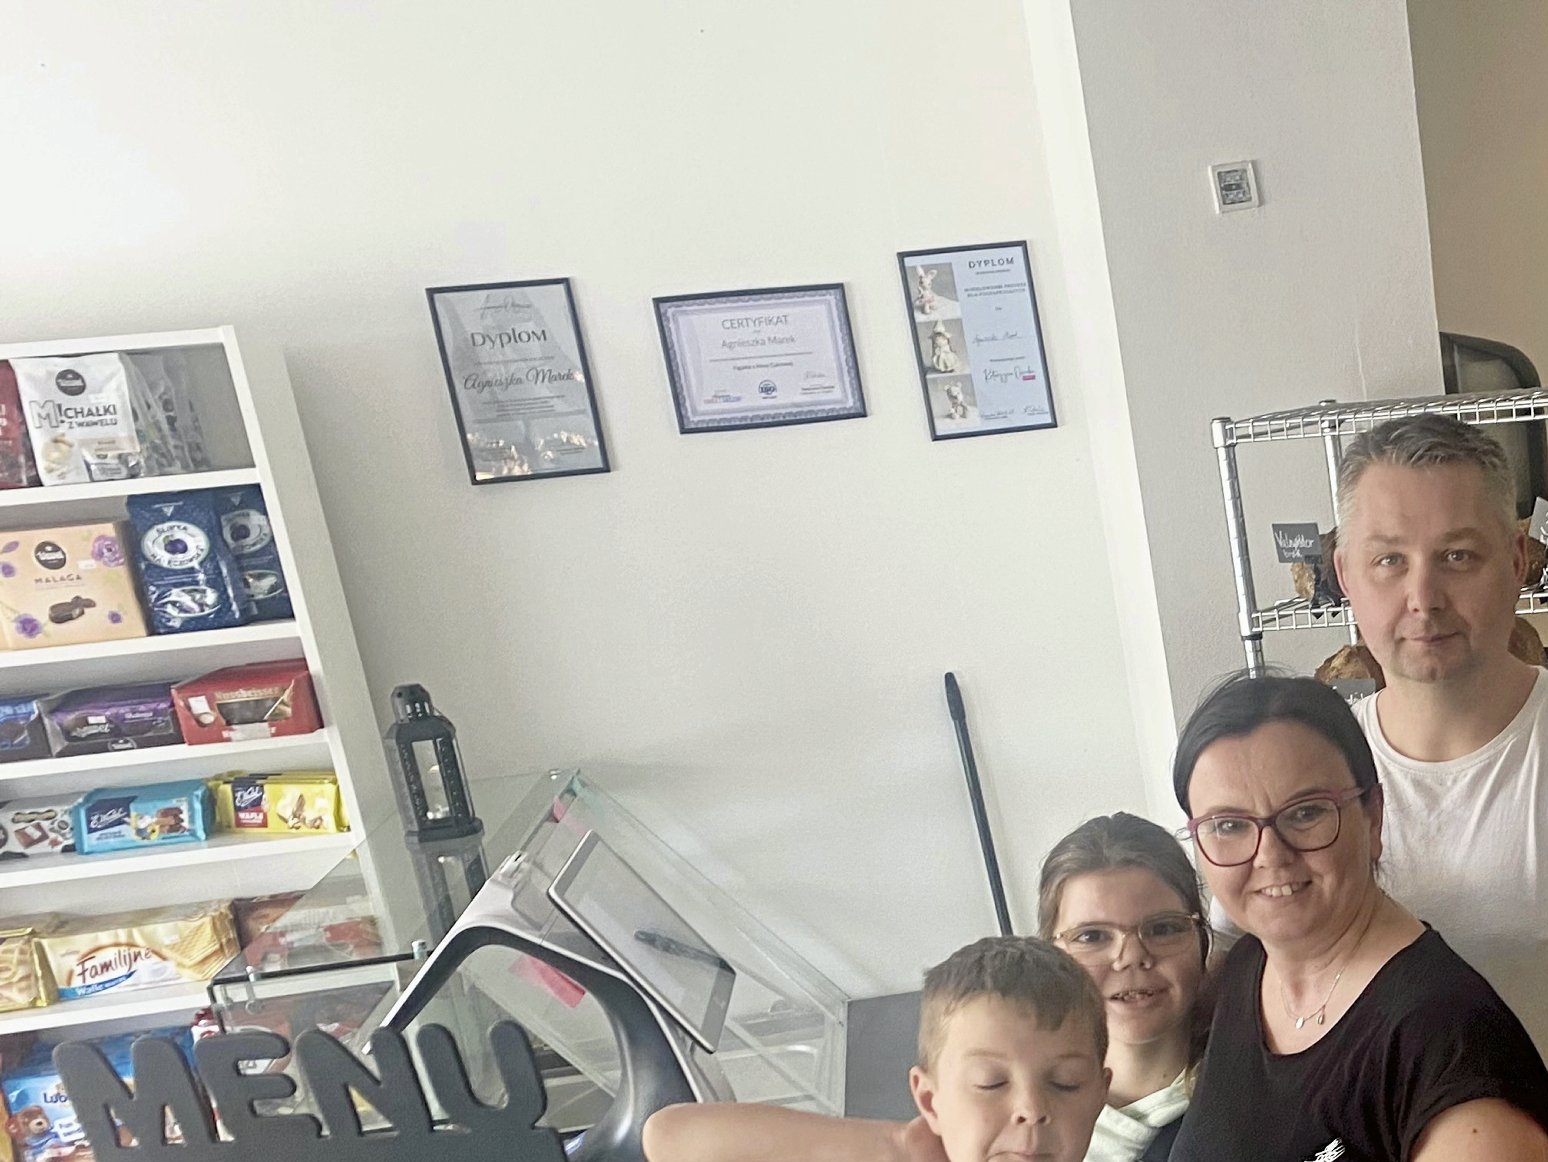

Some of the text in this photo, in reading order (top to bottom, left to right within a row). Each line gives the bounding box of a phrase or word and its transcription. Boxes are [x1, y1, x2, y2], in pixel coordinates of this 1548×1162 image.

[968, 256, 1014, 269] DYPLOM
[721, 314, 789, 330] CERTYFIKAT
[462, 366, 574, 394] Agnieszka Marek
[34, 573, 83, 585] MALAGA
[76, 947, 153, 984] Familijne
[52, 1021, 549, 1148] MENU
